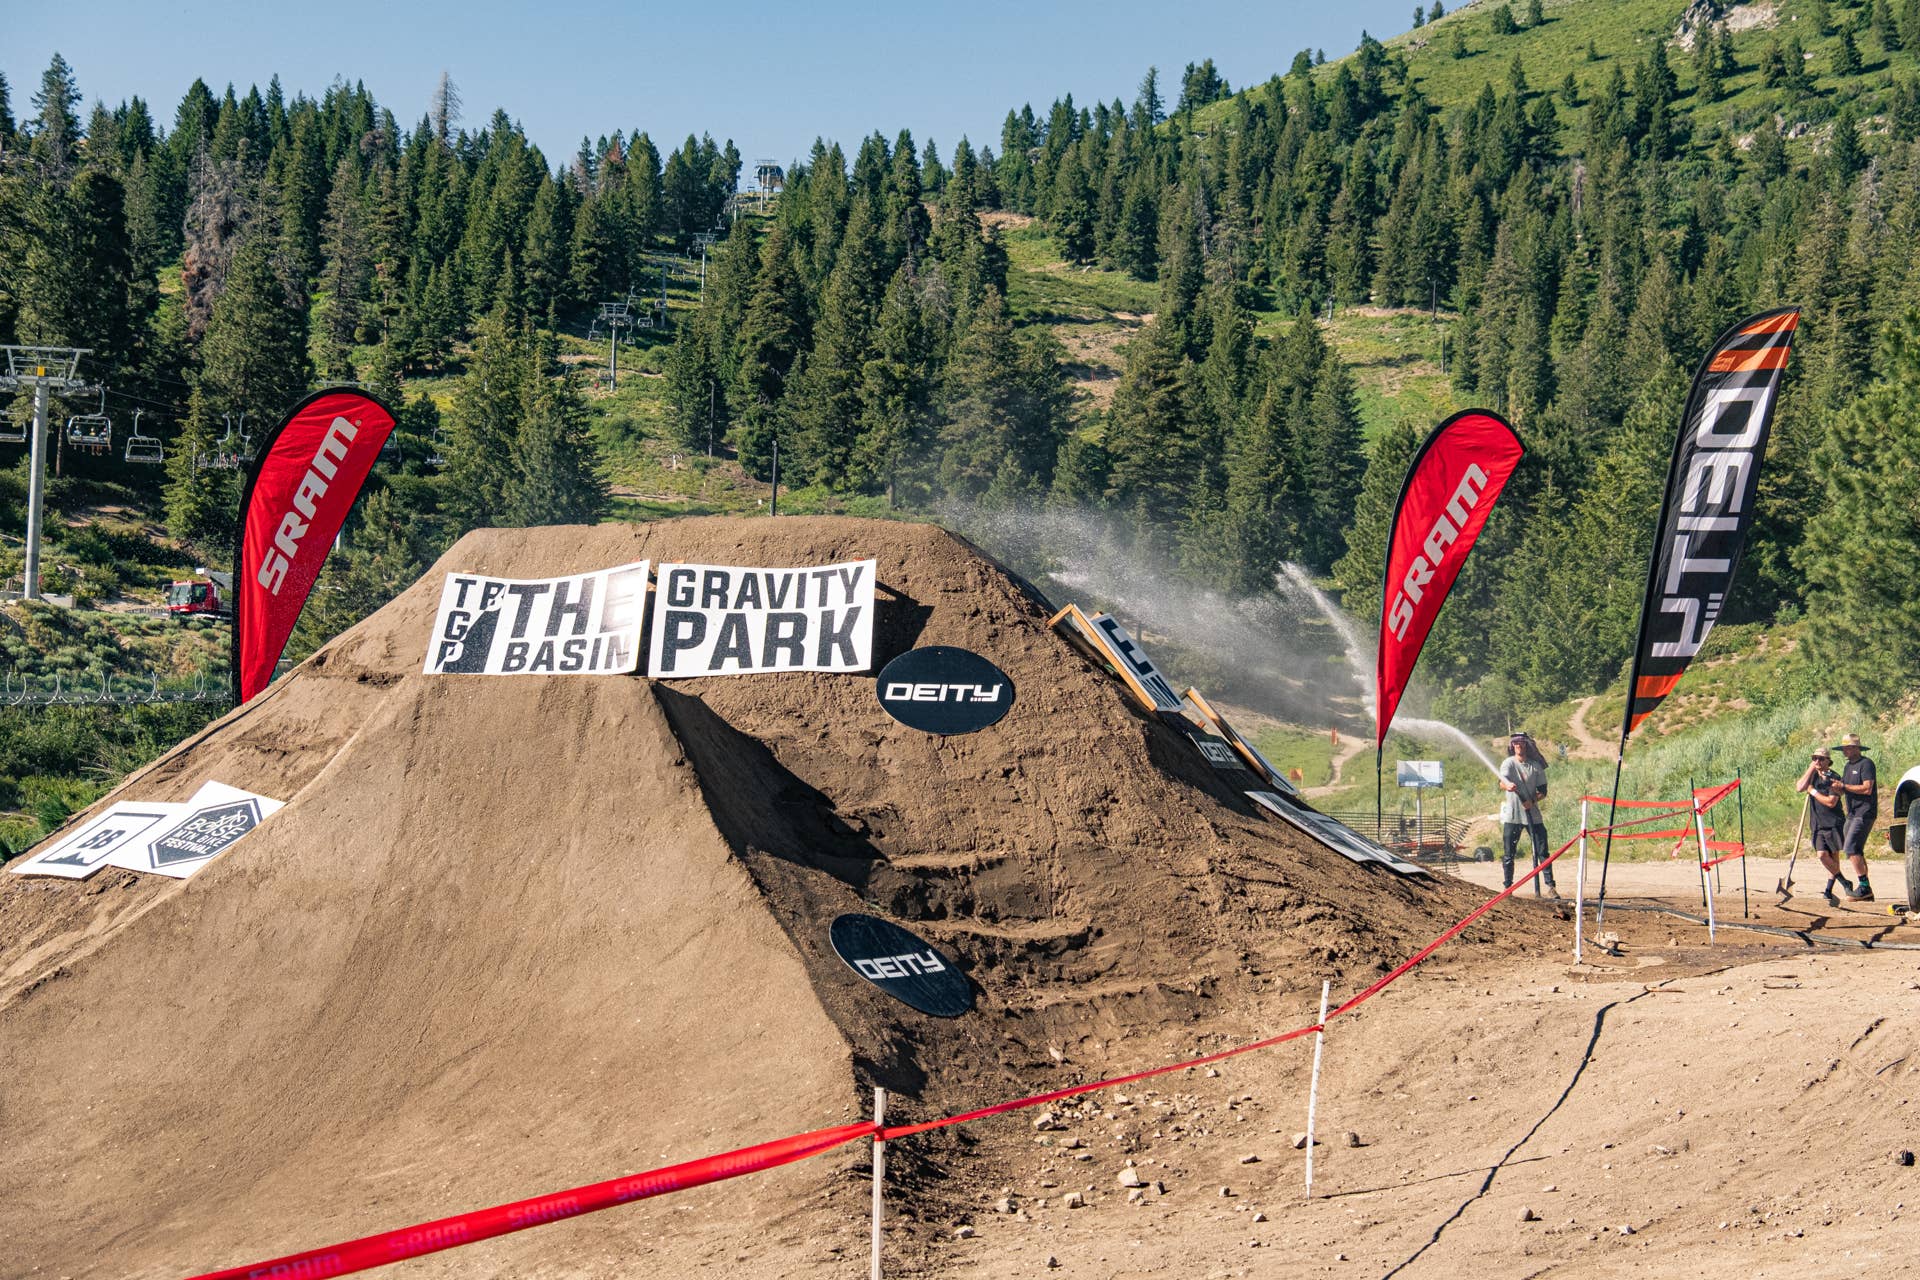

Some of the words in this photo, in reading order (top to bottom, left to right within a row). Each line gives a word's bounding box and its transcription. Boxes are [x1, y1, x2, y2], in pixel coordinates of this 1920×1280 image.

[257, 416, 359, 597] SRAM
[1388, 462, 1488, 642] SRAM
[507, 567, 642, 639] THE
[667, 567, 864, 610] GRAVITY
[501, 634, 631, 672] BASIN
[660, 606, 861, 672] PARK
[885, 682, 1002, 702] DEITY
[161, 838, 212, 854] FESTIVAL
[184, 818, 246, 840] BOISE
[197, 835, 227, 847] BIKE
[853, 950, 946, 979] DEITY
[614, 1171, 681, 1201] SRAM
[507, 1195, 581, 1228] SRAM
[387, 1221, 470, 1259] SRAM
